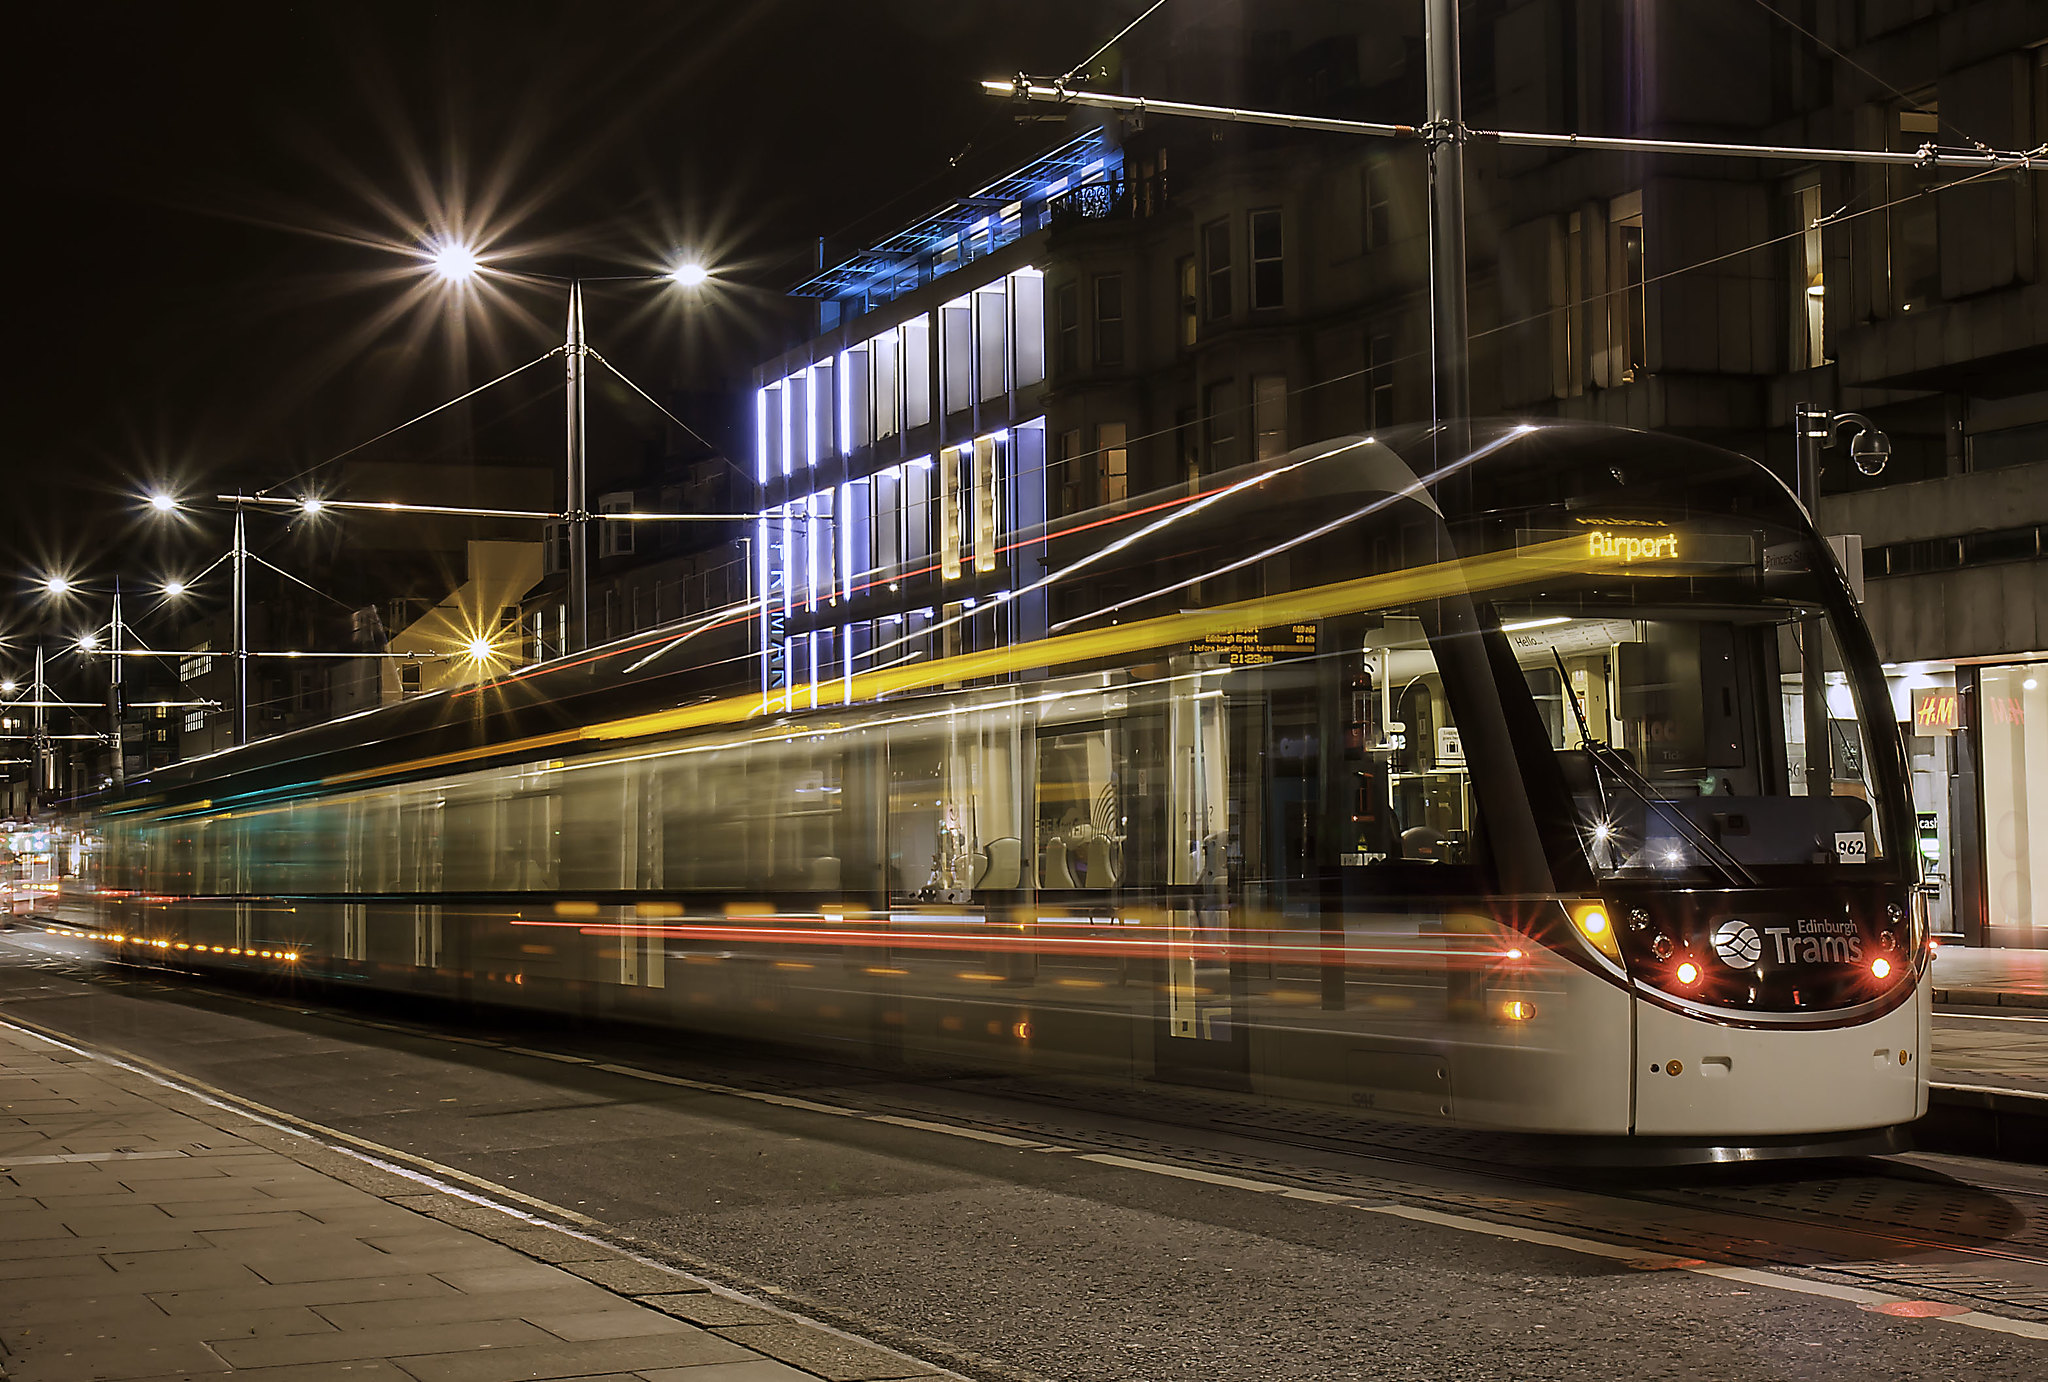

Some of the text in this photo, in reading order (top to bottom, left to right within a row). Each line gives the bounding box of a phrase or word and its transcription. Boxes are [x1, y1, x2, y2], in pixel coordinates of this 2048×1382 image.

[1589, 531, 1679, 562] Airport
[1918, 697, 1956, 726] H&M
[1838, 840, 1866, 855] 962
[1797, 919, 1858, 936] Edinburgh
[1764, 927, 1863, 964] Trams
